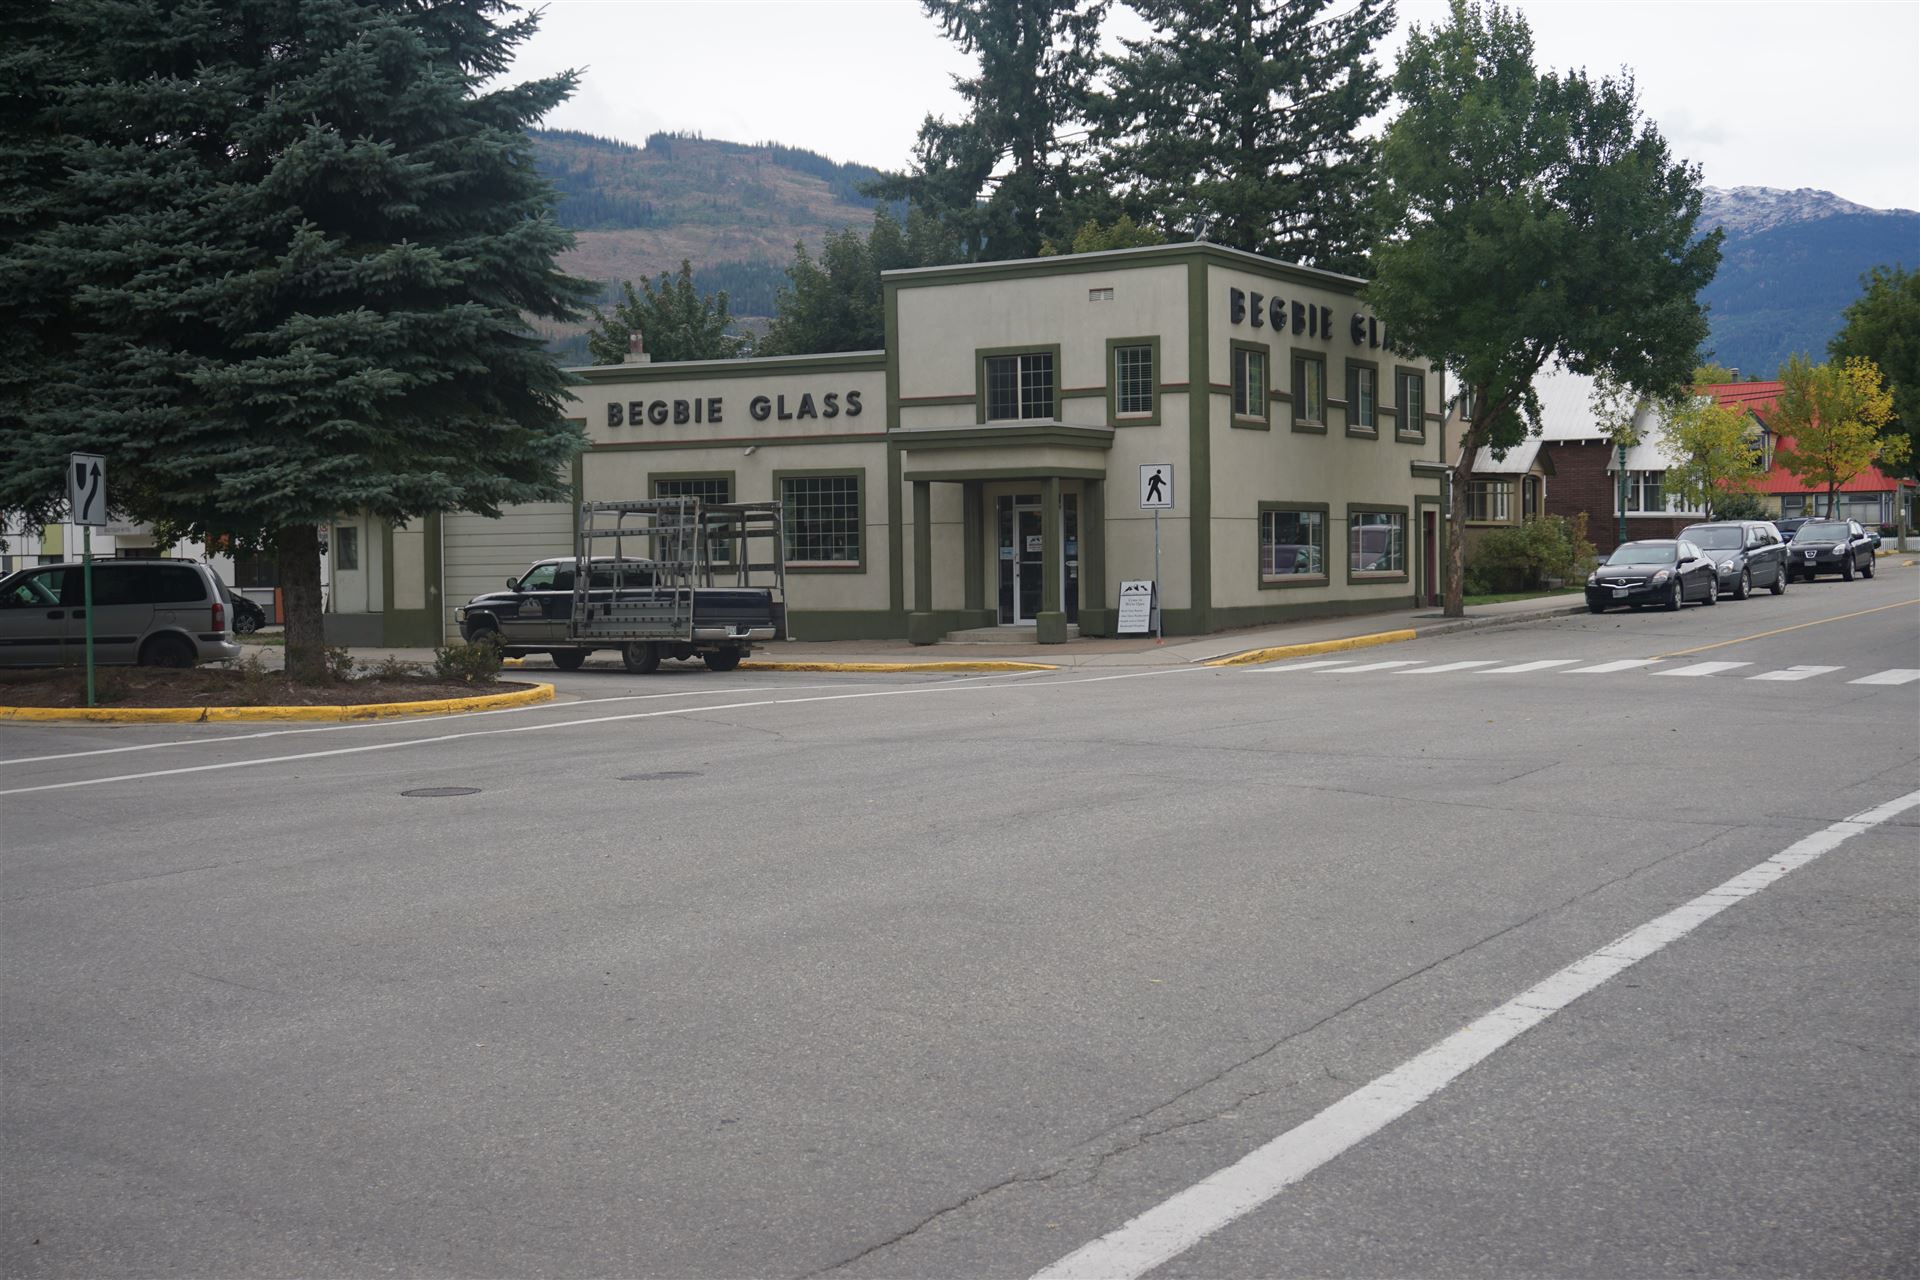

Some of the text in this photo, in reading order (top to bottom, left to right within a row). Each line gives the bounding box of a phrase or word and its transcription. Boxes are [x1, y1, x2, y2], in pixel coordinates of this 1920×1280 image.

[1230, 287, 1333, 341] BEGBIE
[607, 390, 863, 428] BEGBIE GLASS
